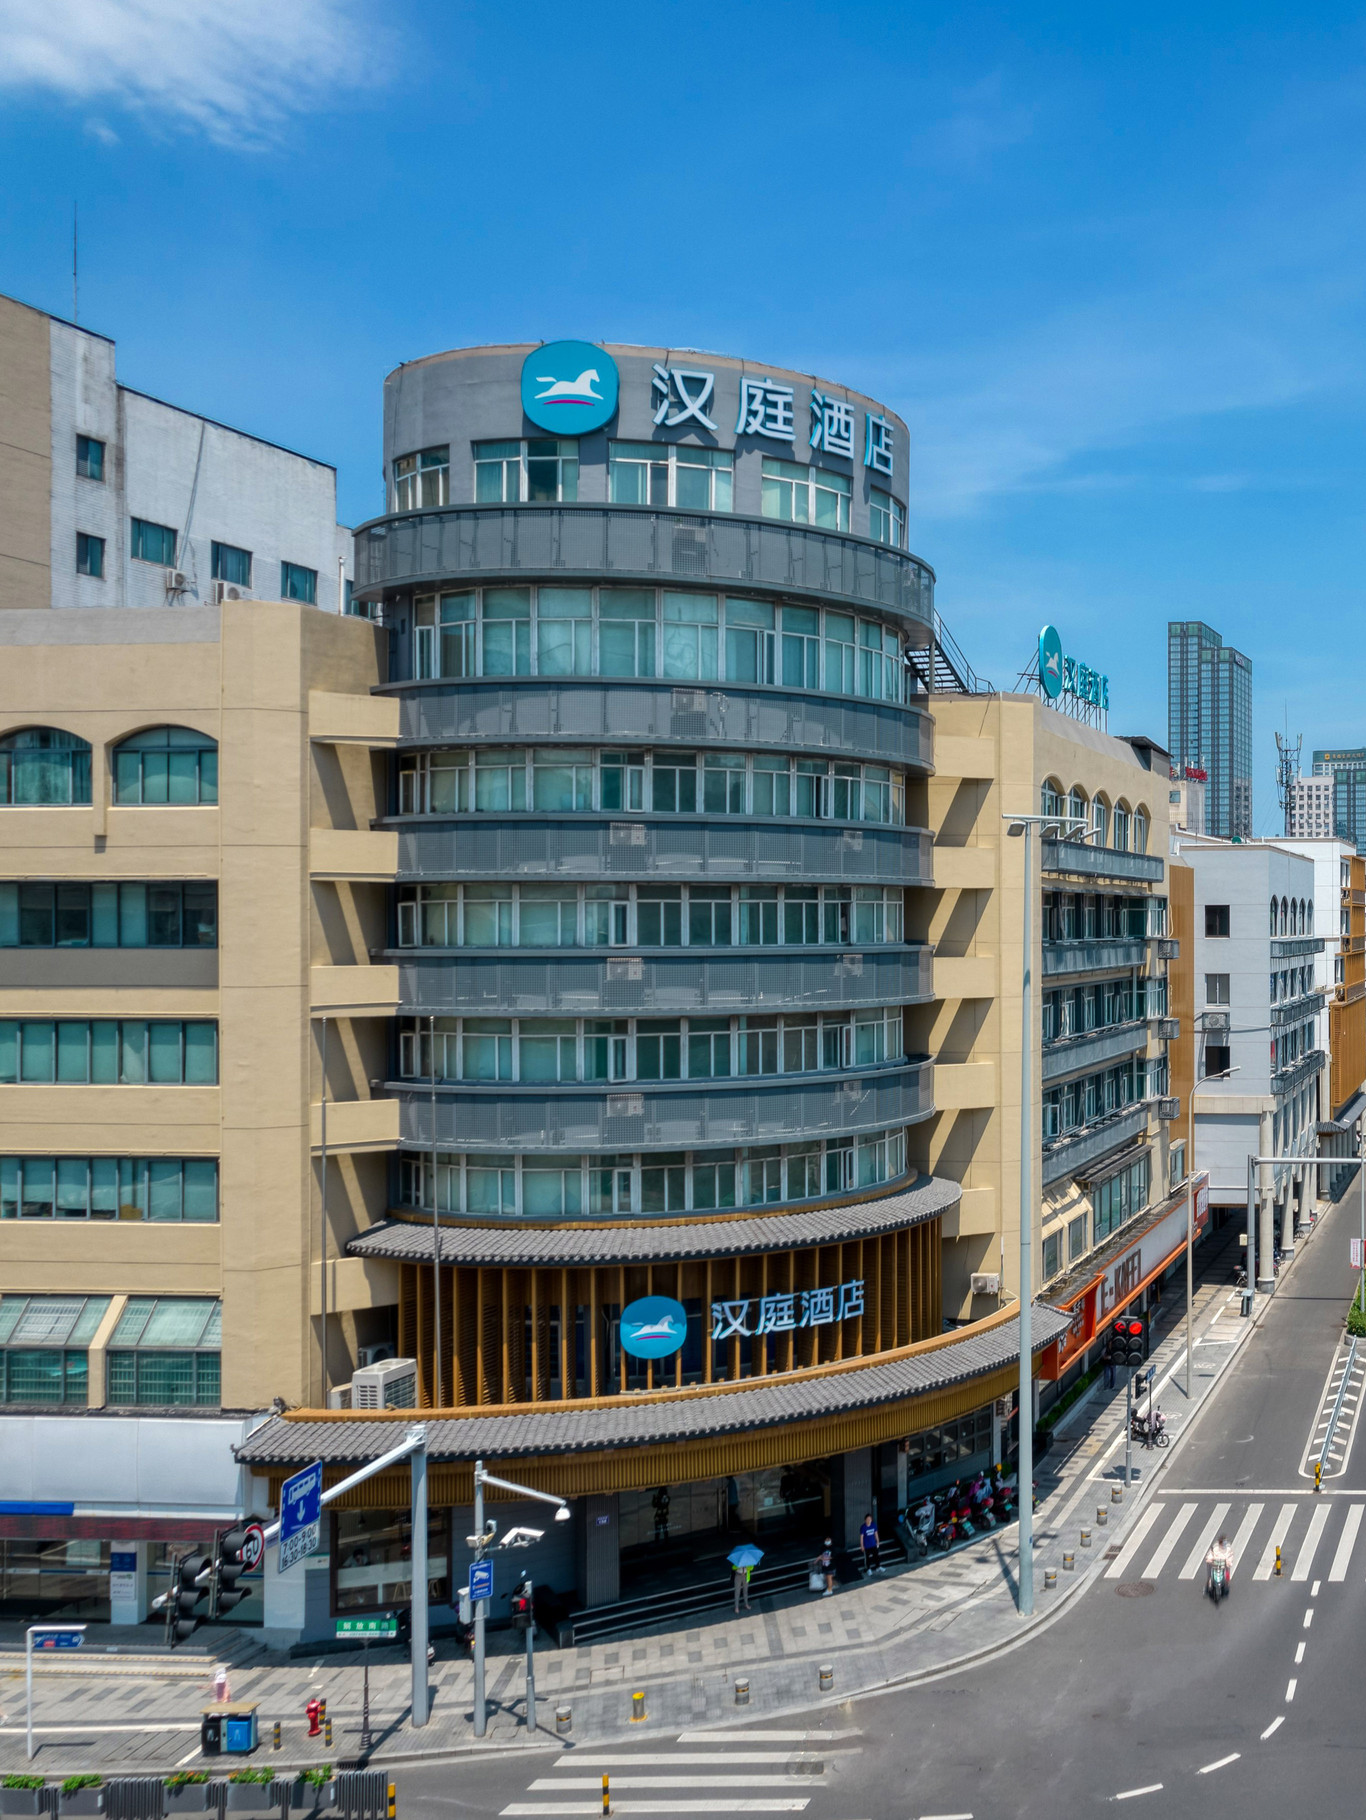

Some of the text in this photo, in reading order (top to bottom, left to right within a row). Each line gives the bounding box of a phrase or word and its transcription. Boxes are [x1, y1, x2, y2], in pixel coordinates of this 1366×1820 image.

[652, 363, 894, 477] 汉庭酒店
[711, 1279, 865, 1340] 汉庭酒店
